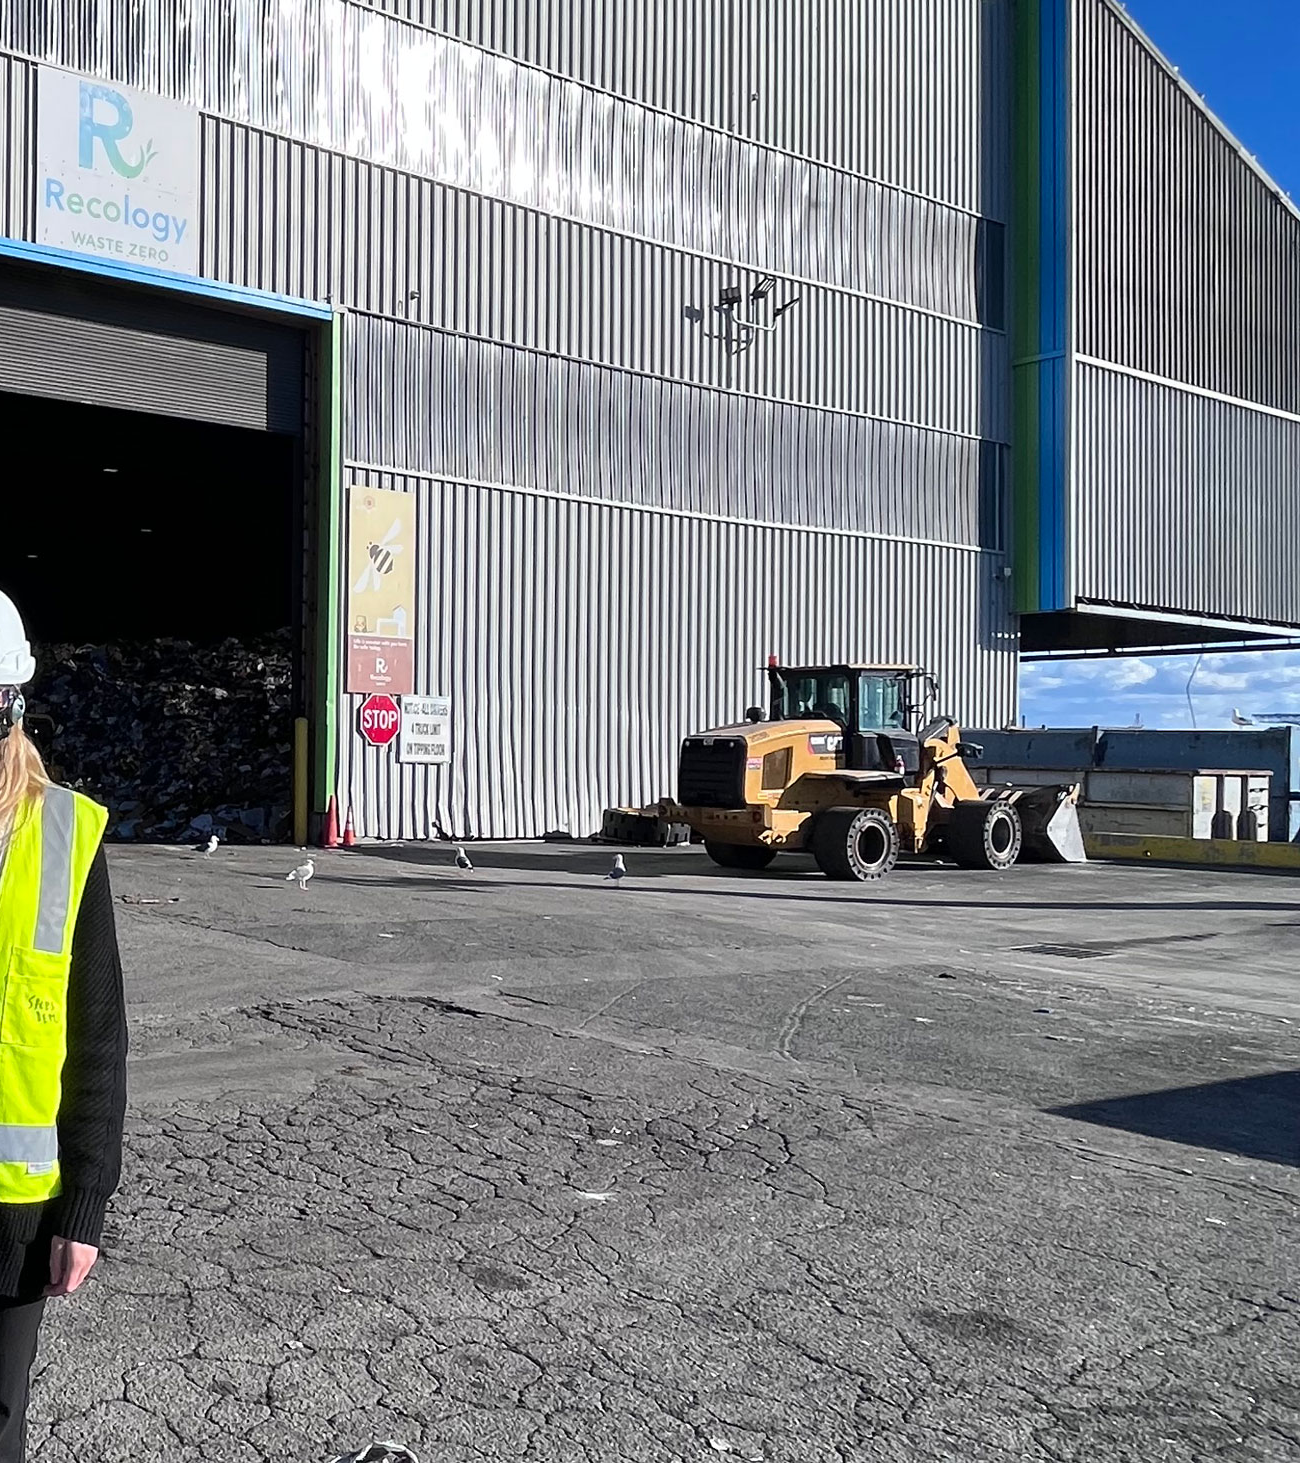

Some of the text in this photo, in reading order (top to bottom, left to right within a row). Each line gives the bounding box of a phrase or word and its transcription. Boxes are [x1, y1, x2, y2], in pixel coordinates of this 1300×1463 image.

[45, 178, 187, 245] Recology
[71, 230, 169, 262] WASTE ZERO
[363, 709, 398, 729] STOP
